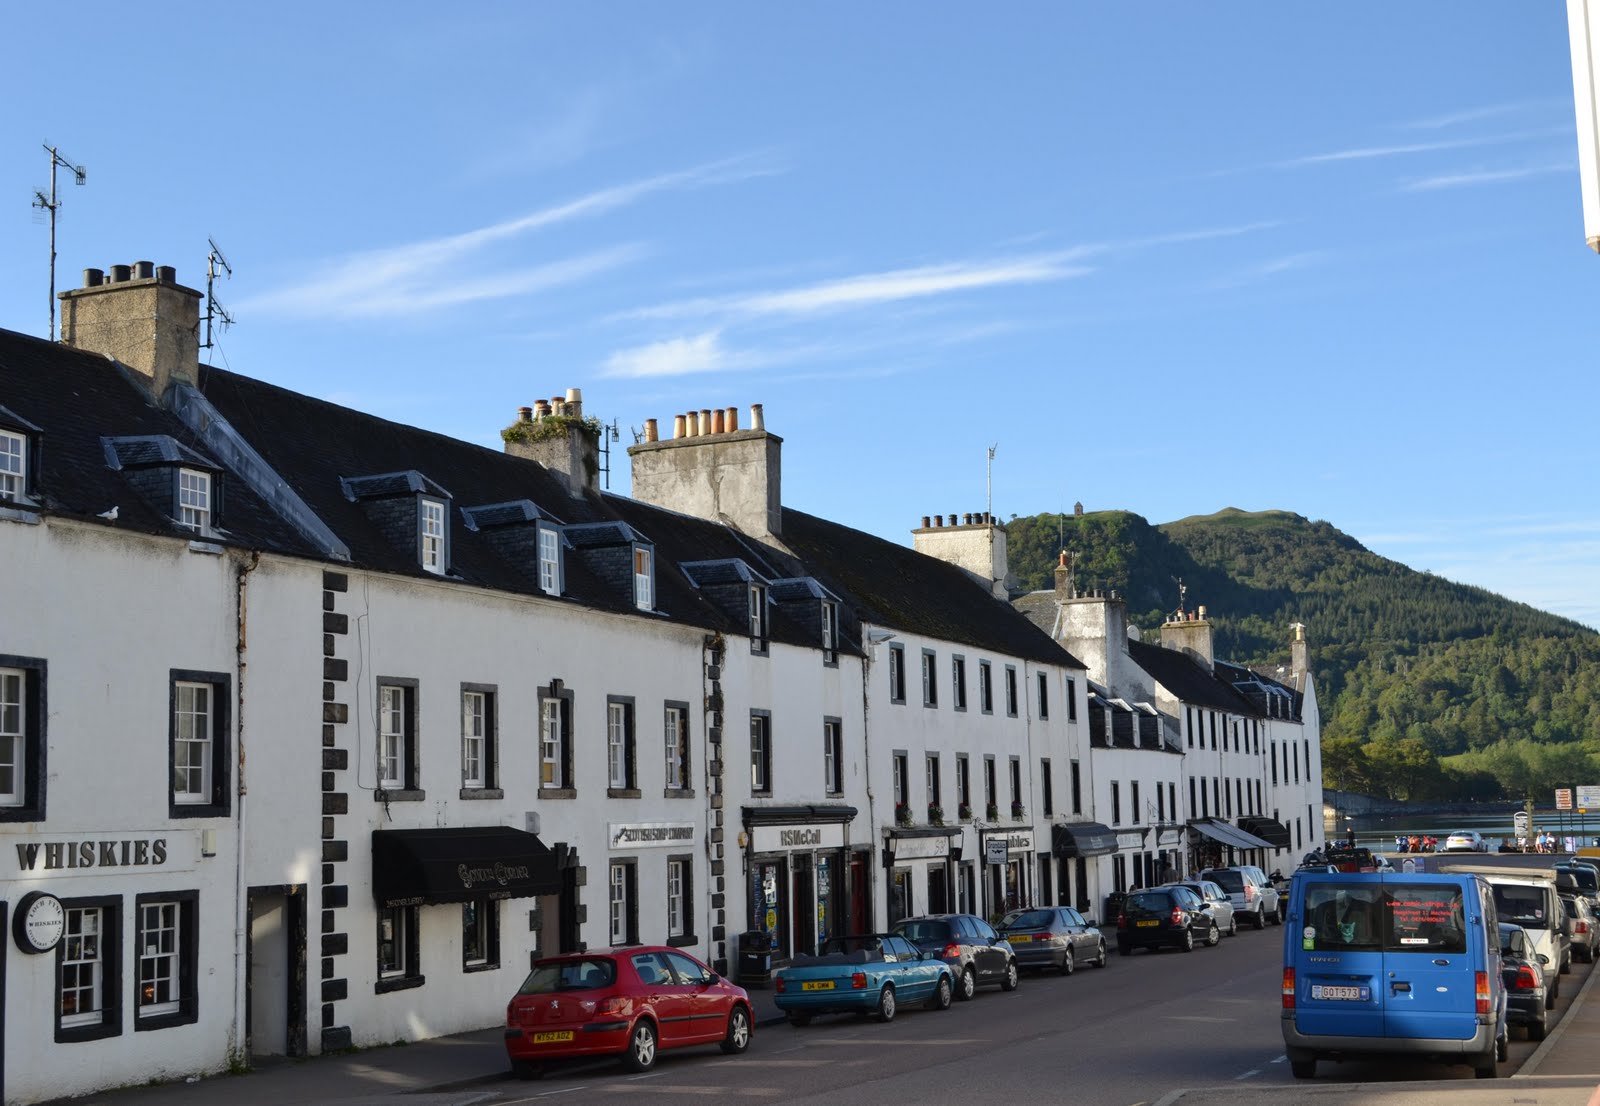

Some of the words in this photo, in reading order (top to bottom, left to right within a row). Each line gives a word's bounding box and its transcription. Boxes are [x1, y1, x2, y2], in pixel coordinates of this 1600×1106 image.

[16, 839, 167, 871] WHISKIES
[30, 900, 44, 917] LOCH
[29, 920, 62, 928] WHISKIES
